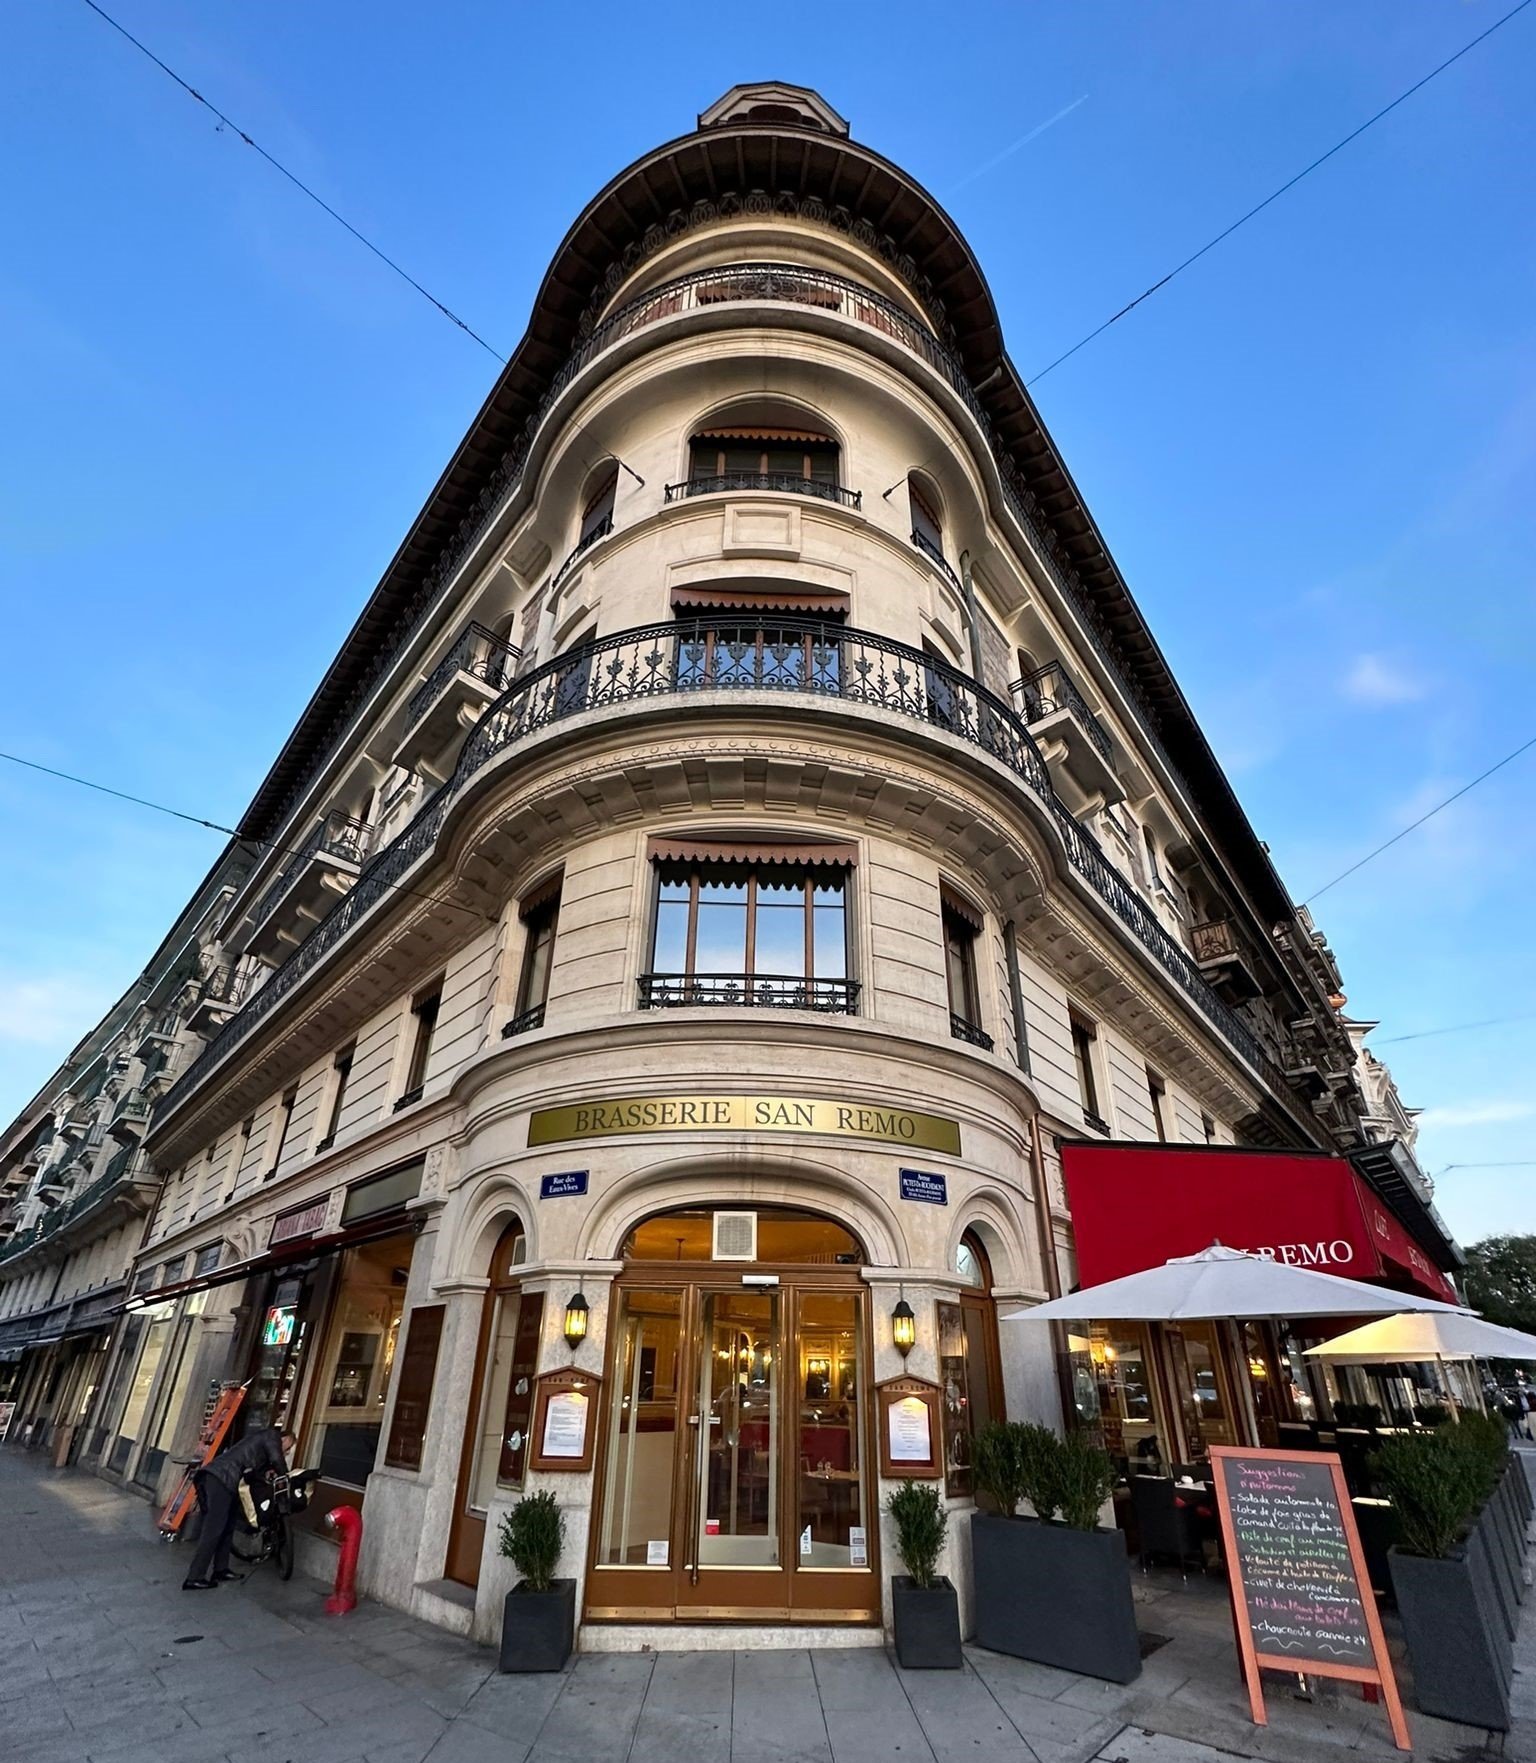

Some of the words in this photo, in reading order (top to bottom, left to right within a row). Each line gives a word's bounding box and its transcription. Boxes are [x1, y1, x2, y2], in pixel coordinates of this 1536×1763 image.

[573, 1102, 731, 1133] BRASSERIE
[754, 1102, 816, 1127] SAN
[837, 1111, 916, 1139] REMO
[565, 1175, 575, 1183] des
[1237, 1463, 1306, 1480] Suggestions
[1237, 1493, 1270, 1505] Salade
[1292, 1511, 1317, 1520] gras
[1320, 1510, 1331, 1520] de
